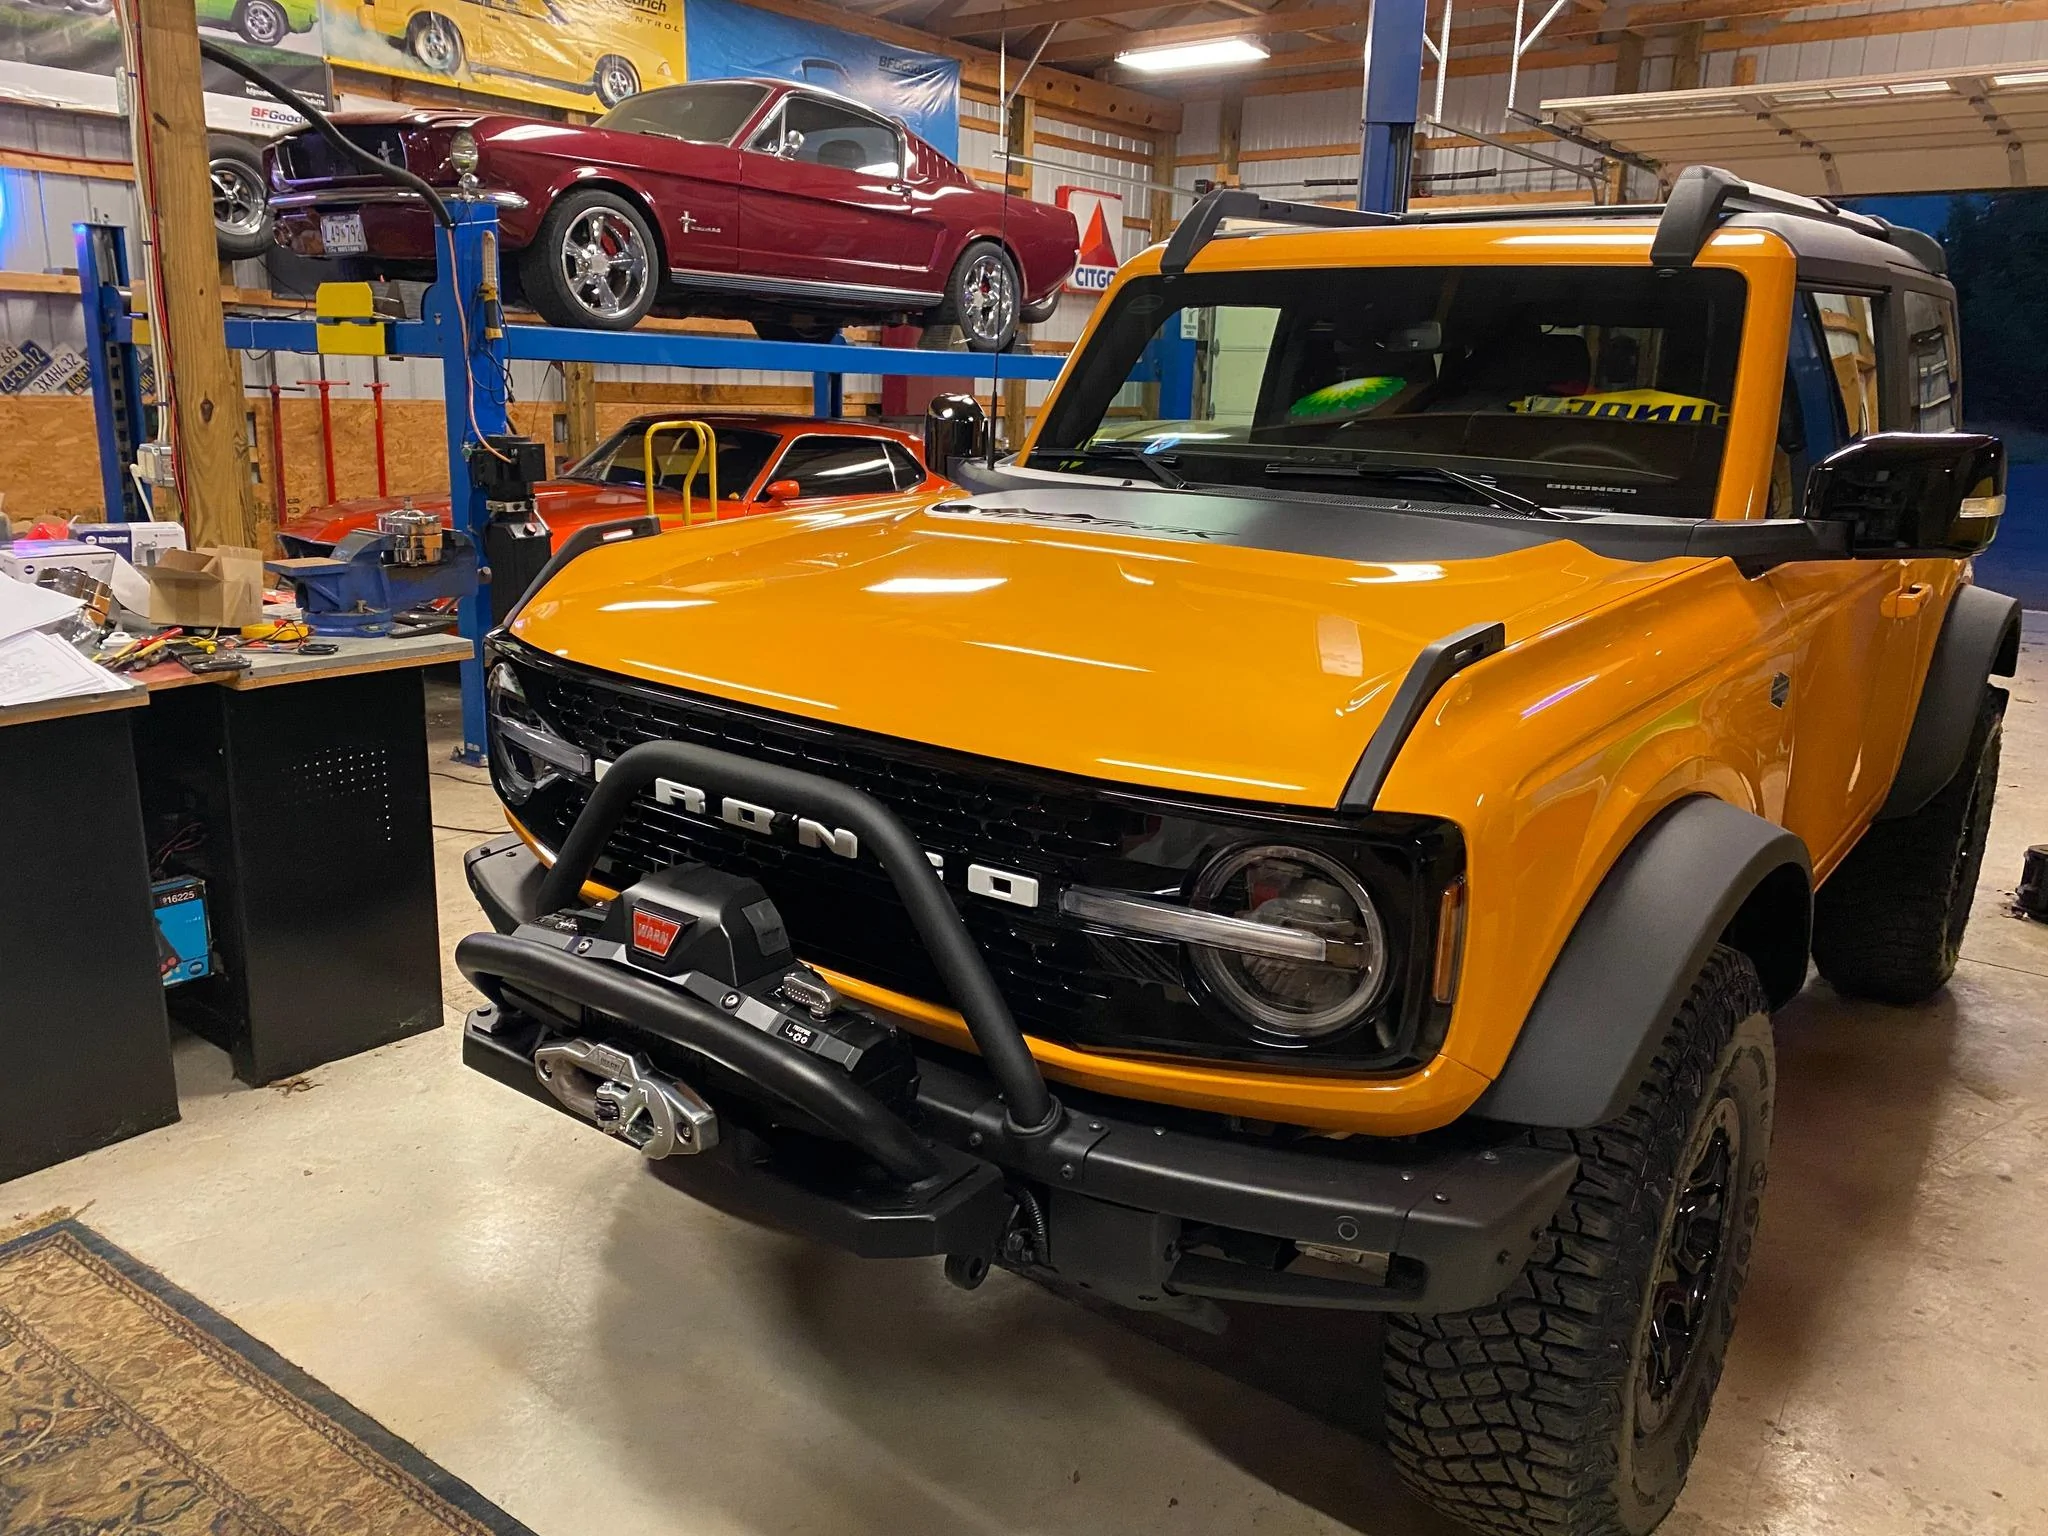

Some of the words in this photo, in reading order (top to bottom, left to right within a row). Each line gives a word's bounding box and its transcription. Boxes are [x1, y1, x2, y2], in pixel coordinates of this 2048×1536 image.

[251, 106, 306, 122] BFGood
[1546, 483, 1637, 495] BRONCO
[595, 758, 1039, 908] RONO
[638, 923, 671, 945] WARN
